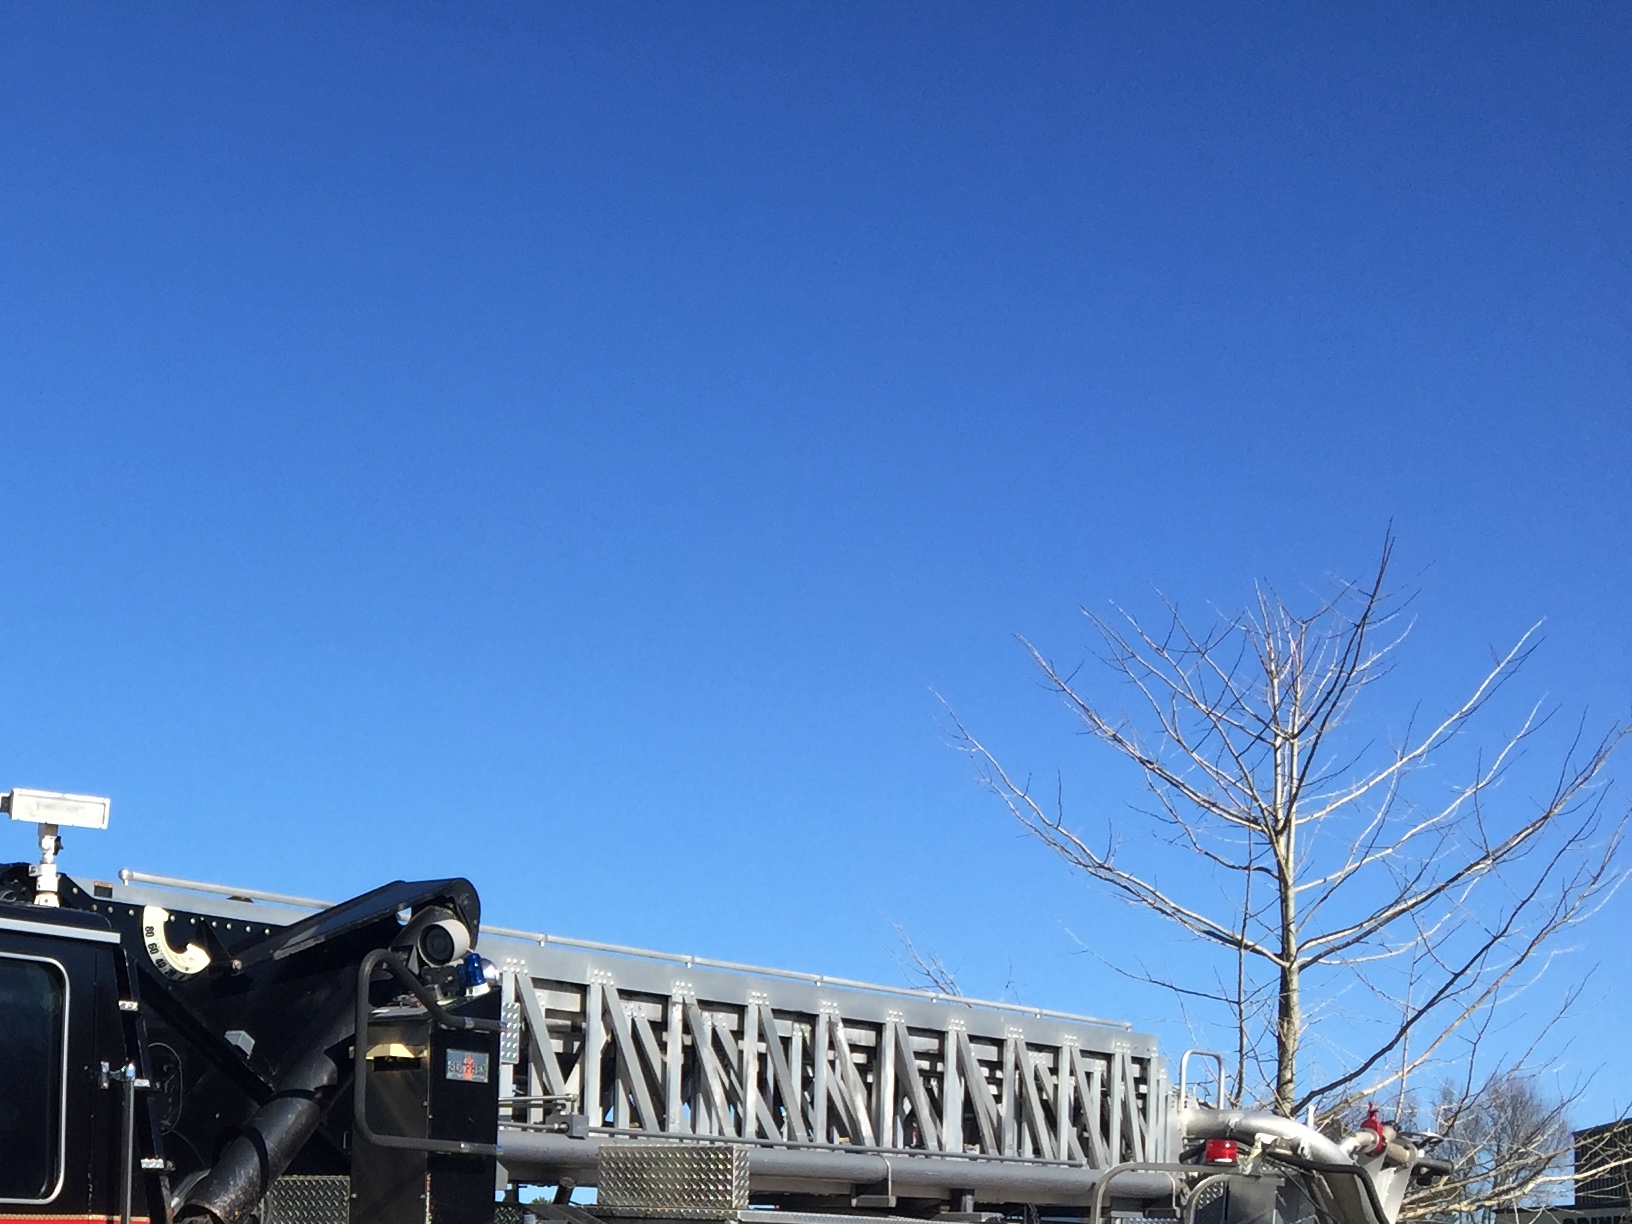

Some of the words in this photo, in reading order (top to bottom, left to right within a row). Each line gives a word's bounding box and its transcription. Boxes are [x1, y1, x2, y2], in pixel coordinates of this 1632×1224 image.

[144, 926, 155, 938] 80
[147, 942, 159, 955] 60
[155, 958, 167, 970] 40
